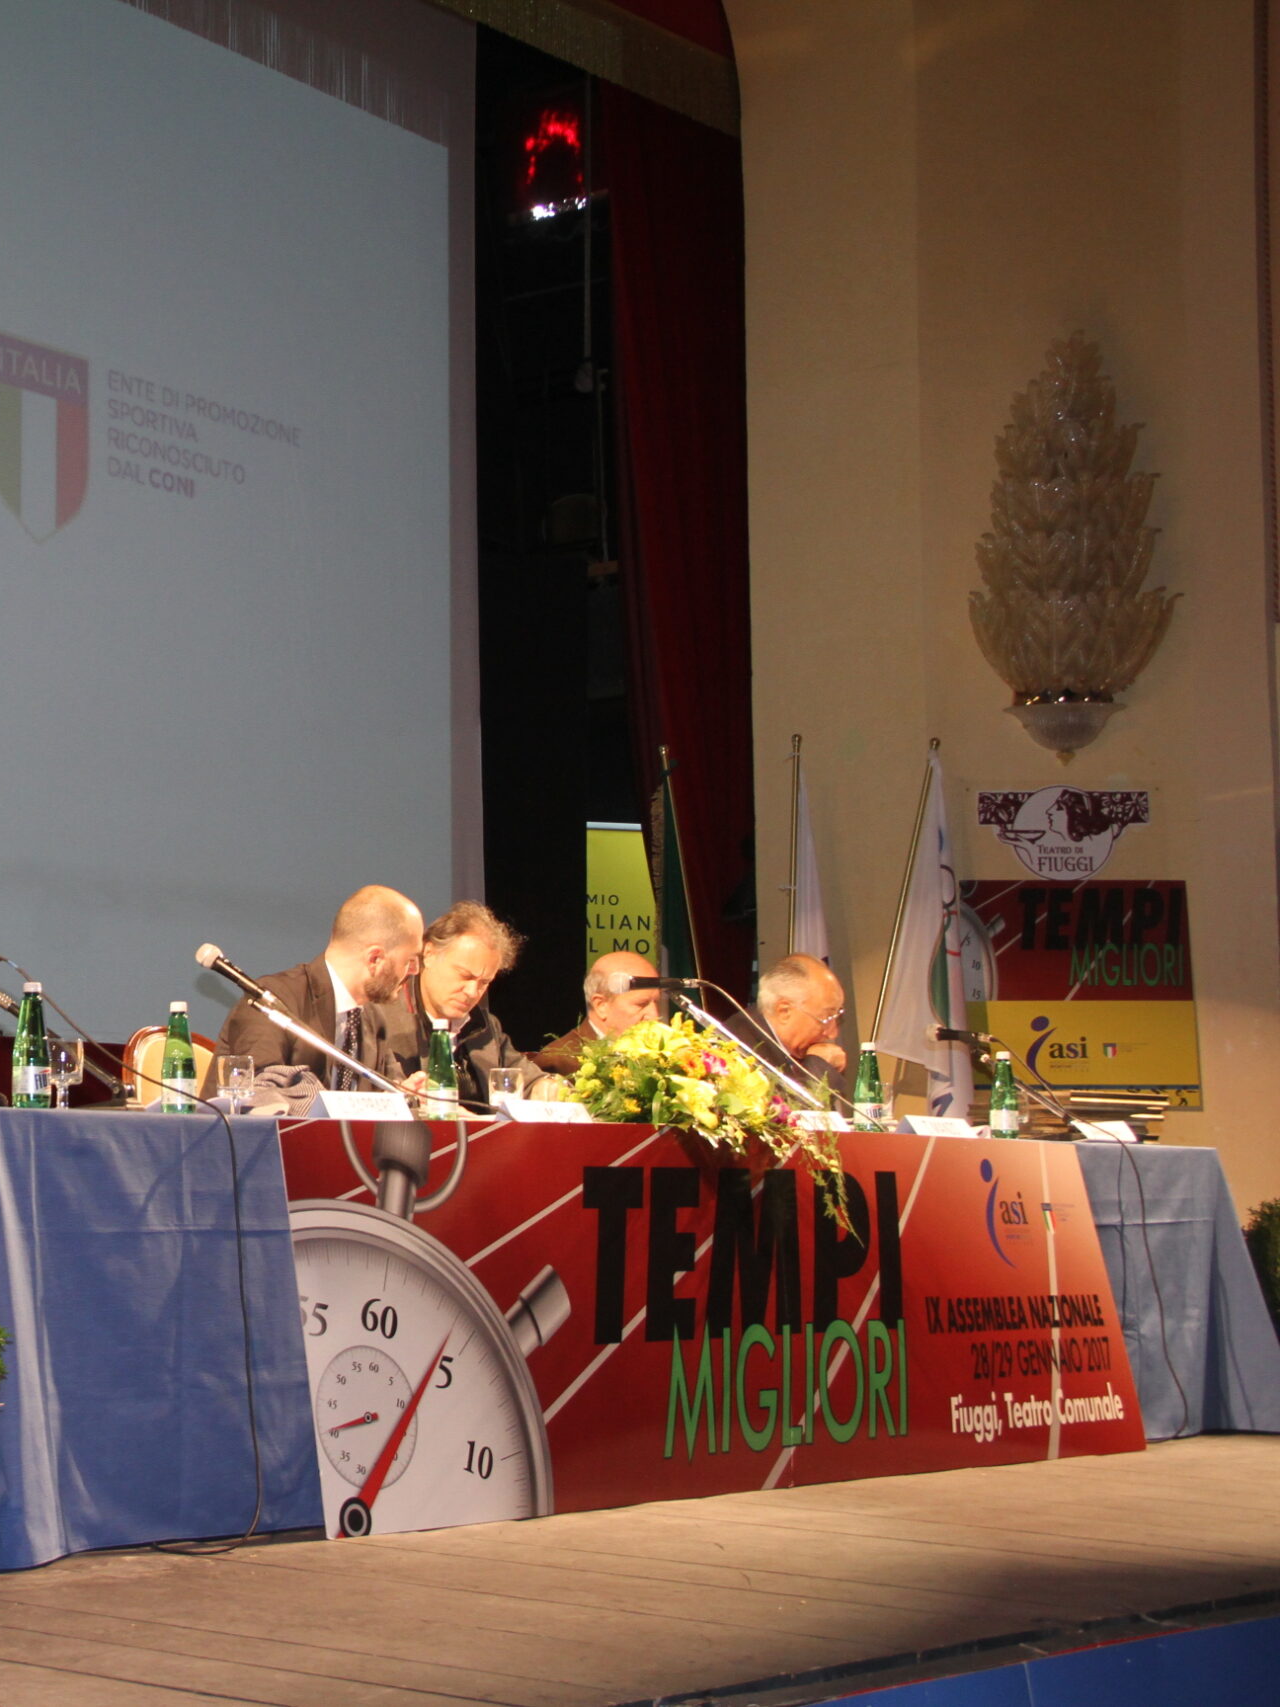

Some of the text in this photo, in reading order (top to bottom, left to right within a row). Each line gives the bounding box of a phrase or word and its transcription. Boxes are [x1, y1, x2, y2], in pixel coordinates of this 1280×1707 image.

[108, 370, 302, 448] ENTE DI PROMOZIONE
[108, 399, 199, 443] SPORTIVA
[108, 428, 246, 485] RICONOSCIUTO
[108, 457, 195, 499] DAL CONI
[1037, 857, 1094, 873] FIUGGI
[586, 894, 619, 906] MIO
[1018, 887, 1183, 951] TEMPI
[971, 959, 981, 971] 10
[1069, 943, 1184, 987] MIGLIORI
[972, 988, 982, 1000] 15
[1049, 1036, 1088, 1059] asi
[999, 1191, 1029, 1225] asi
[582, 1166, 904, 1345] TEMPI
[361, 1298, 398, 1339] 60
[925, 1294, 1105, 1335] IX ASSEMBLEA NAZIONALE
[352, 1361, 362, 1373] 55
[368, 1361, 380, 1373] 60
[435, 1355, 454, 1389] 5
[971, 1336, 1111, 1387] 28/29 GENNAIO 2017
[336, 1374, 347, 1385] 50
[388, 1376, 395, 1386] 5
[663, 1318, 908, 1462] MIGLIORI
[396, 1398, 405, 1409] 10
[950, 1382, 1124, 1443] Fiuggi, Teatro Comunale
[340, 1450, 351, 1462] 35
[356, 1464, 367, 1475] 30
[463, 1439, 494, 1480] 10
